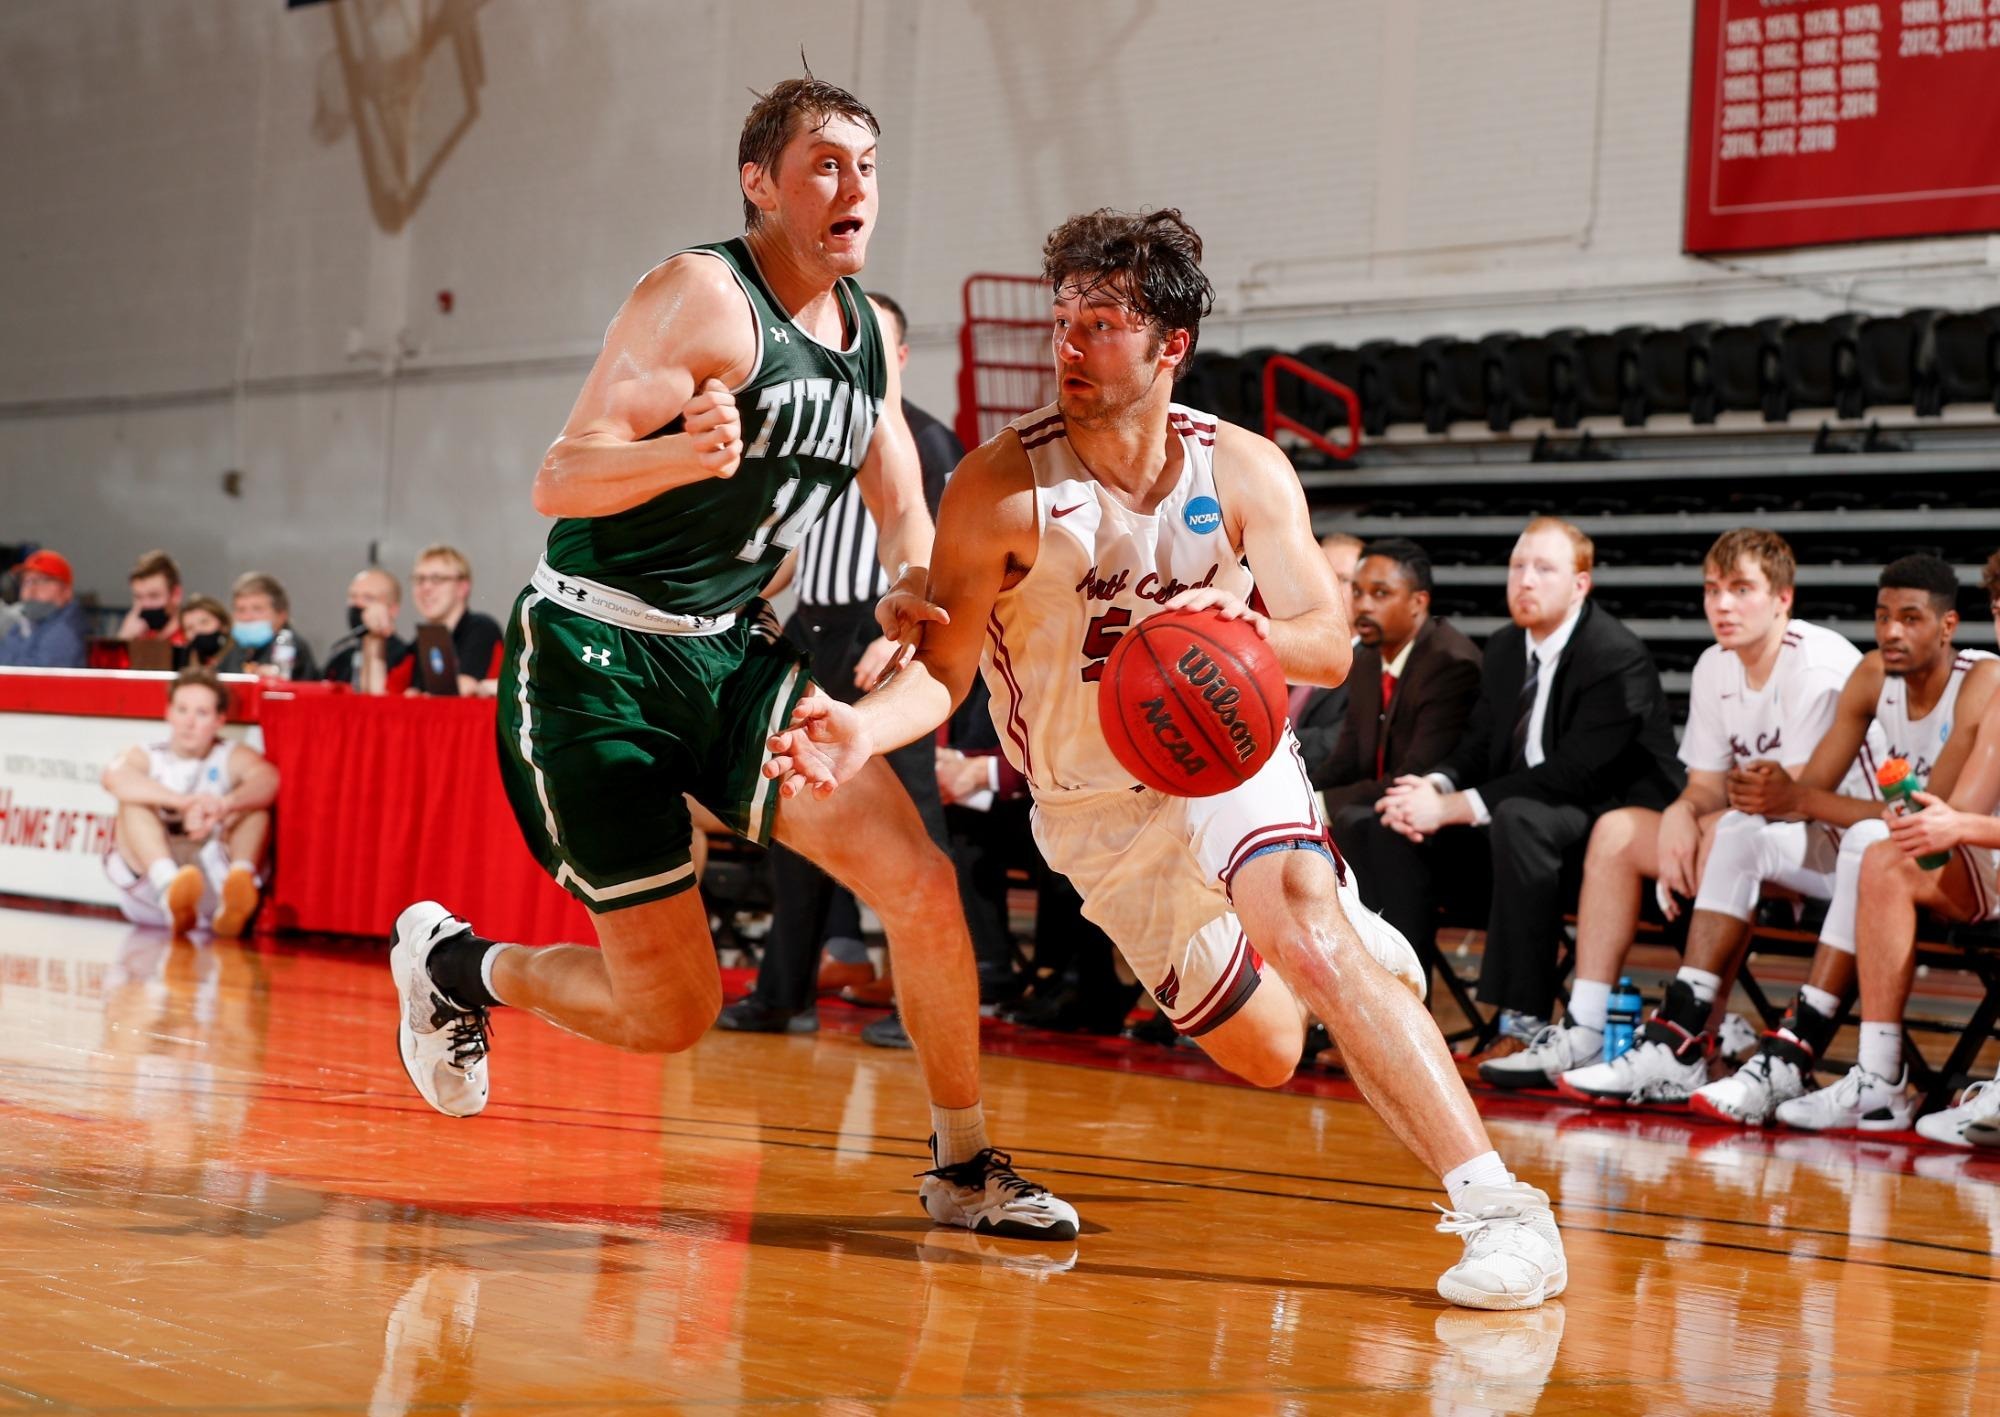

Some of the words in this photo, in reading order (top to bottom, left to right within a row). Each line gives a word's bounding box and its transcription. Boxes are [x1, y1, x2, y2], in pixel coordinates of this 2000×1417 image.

[745, 378, 883, 470] TITAN
[735, 477, 832, 564] 14
[1189, 512, 1220, 526] NCAA
[591, 596, 642, 618] ARMOUR
[1081, 607, 1132, 683] 5
[1140, 696, 1208, 777] NCAA
[1176, 642, 1258, 764] Wilson
[0, 787, 51, 849] HOME
[53, 809, 78, 853] OF
